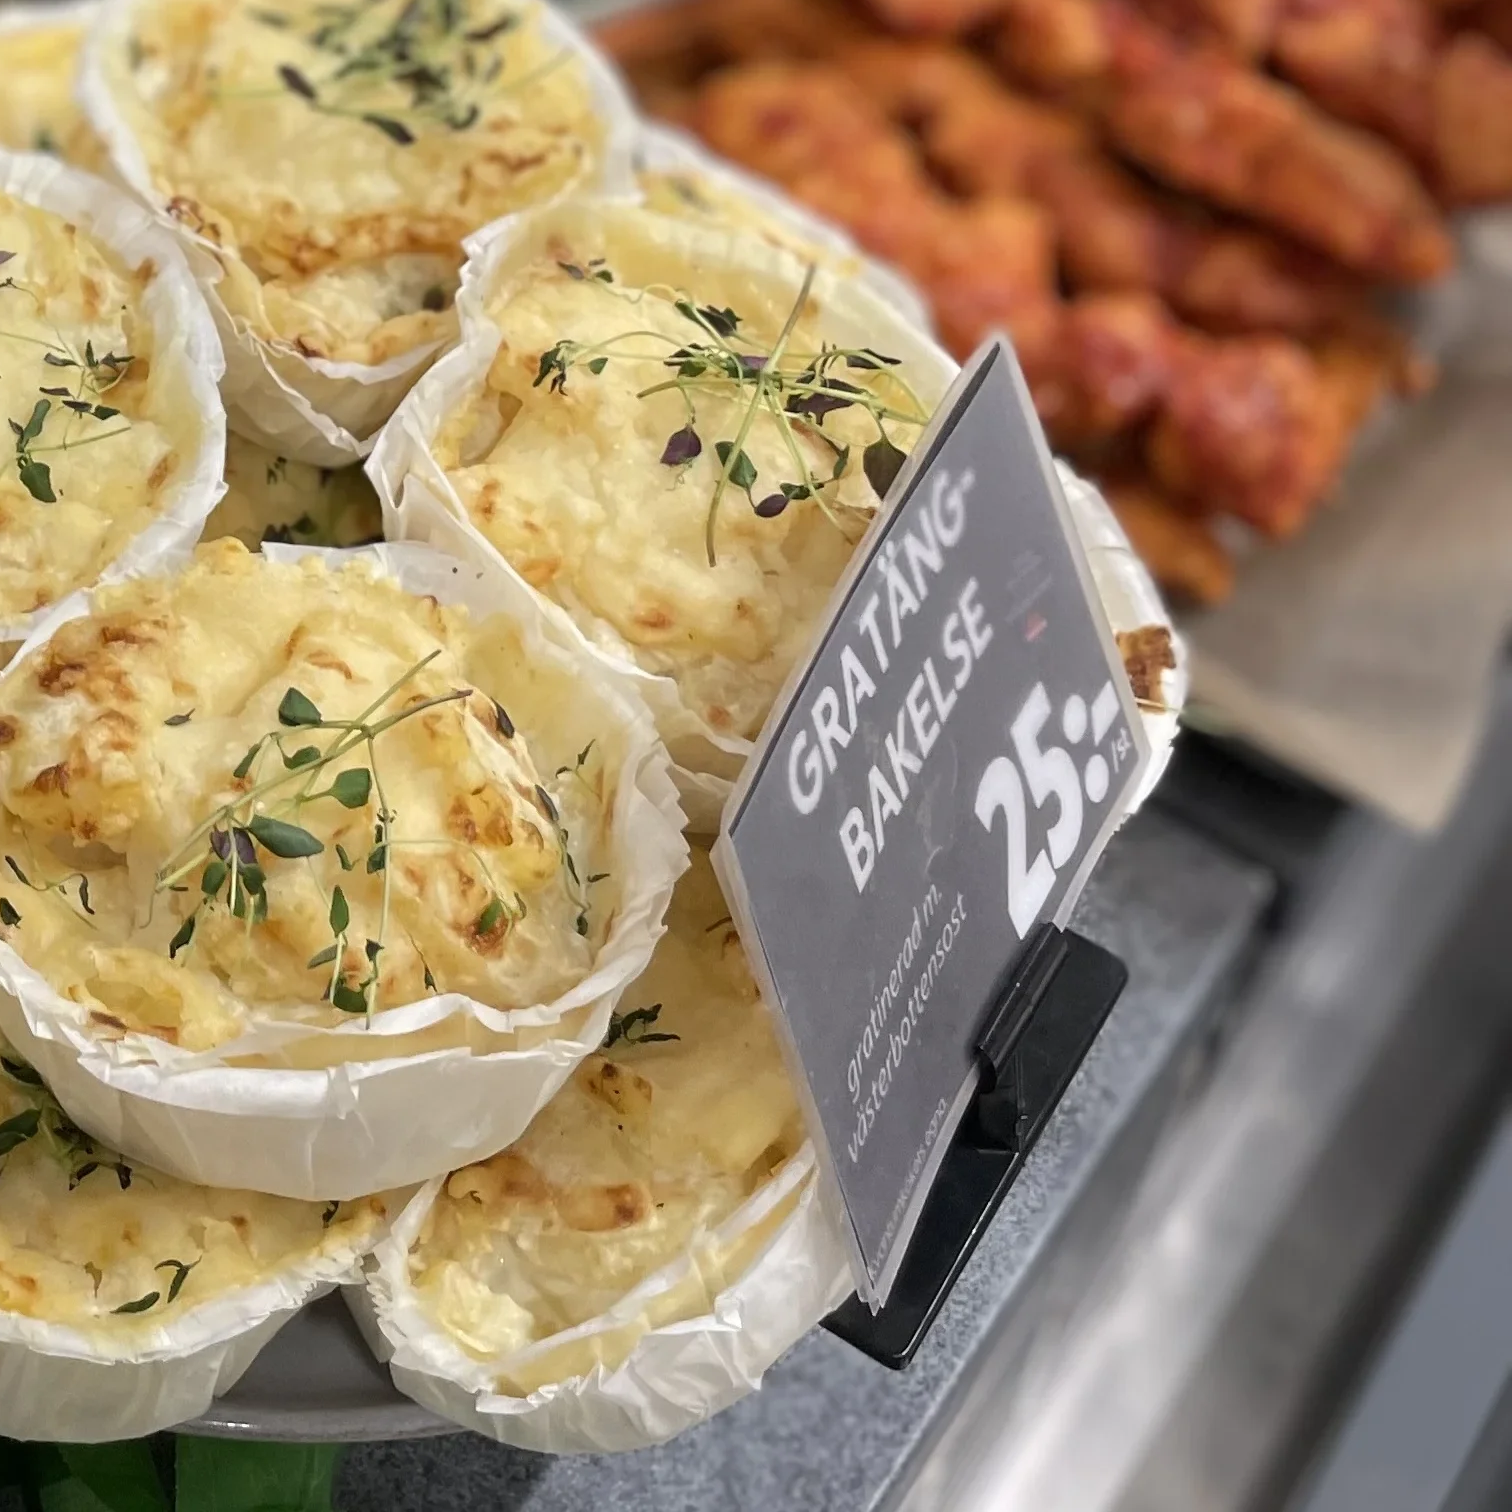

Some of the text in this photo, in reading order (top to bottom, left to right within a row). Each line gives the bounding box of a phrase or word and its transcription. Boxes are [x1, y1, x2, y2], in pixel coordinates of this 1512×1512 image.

[788, 467, 975, 816] GRATÄNG-
[839, 576, 994, 894] BAKELSE
[975, 680, 1120, 940] 25:-
[846, 906, 922, 1105] gratinerad
[923, 884, 944, 928] m.
[846, 892, 968, 1164] västerbottensost
